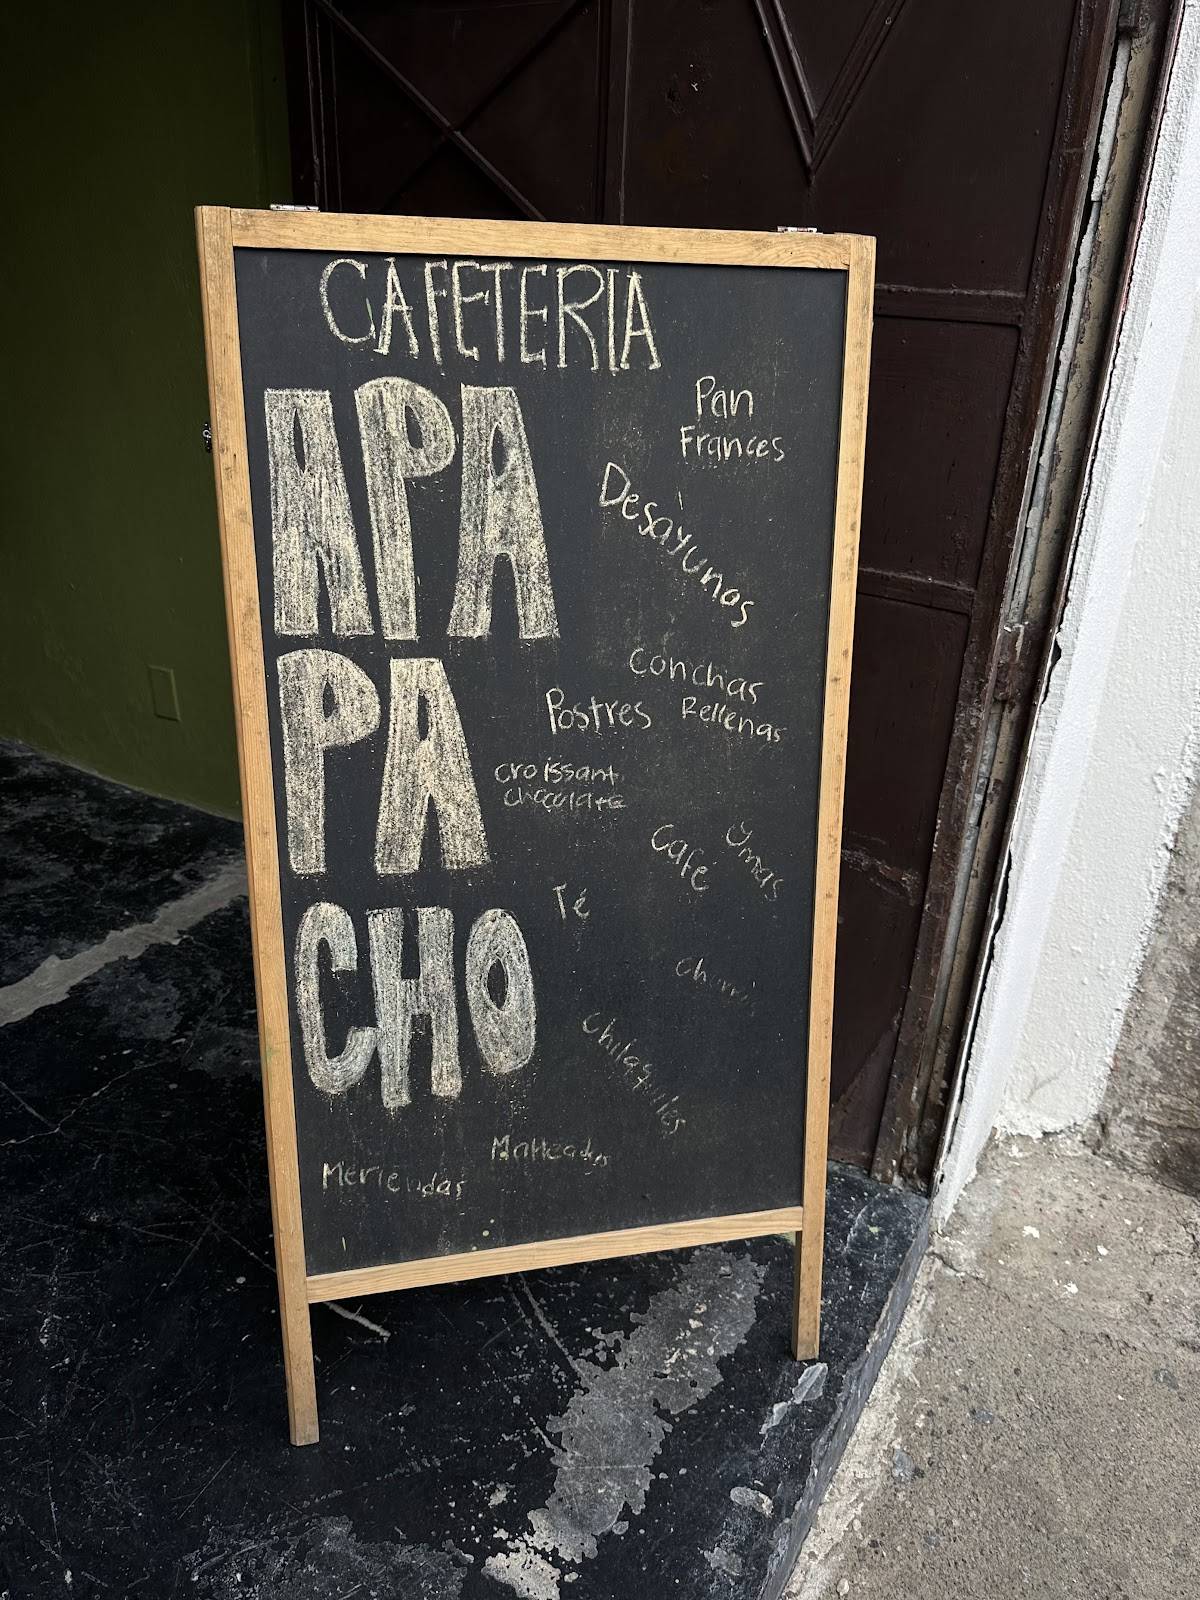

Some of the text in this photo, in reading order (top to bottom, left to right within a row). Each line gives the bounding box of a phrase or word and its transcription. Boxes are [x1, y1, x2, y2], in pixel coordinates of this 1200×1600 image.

[319, 257, 662, 373] CAFETERIA
[696, 375, 754, 420] Pan
[679, 424, 786, 463] Frances
[264, 376, 561, 640] APA
[599, 461, 755, 628] Desayunos
[545, 687, 652, 736] Postres
[629, 646, 765, 705] Conchas
[681, 695, 788, 742] Rellenas
[276, 648, 491, 874] PA
[294, 900, 537, 1109] CHO
